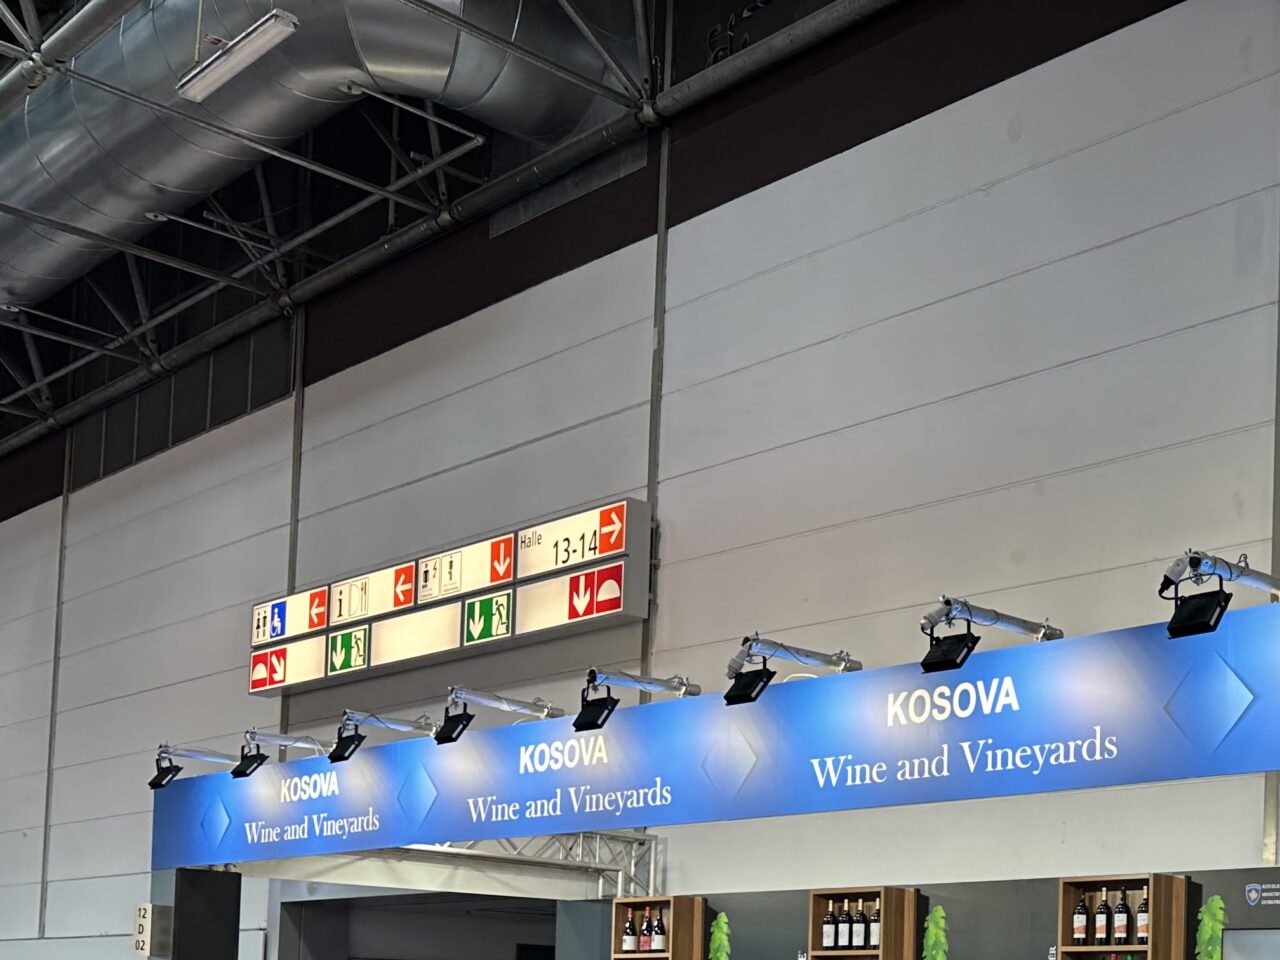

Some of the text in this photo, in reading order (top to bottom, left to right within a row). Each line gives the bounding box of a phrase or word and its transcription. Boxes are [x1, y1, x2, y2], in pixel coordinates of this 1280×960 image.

[520, 529, 598, 565] Halle 13-14
[886, 676, 1020, 727] KOSOVA
[519, 734, 609, 774] KOSOVA
[809, 725, 1118, 788] Wine and Vineyards
[280, 769, 340, 803] KOSOVA
[467, 777, 672, 824] Wine and Vineyards
[244, 805, 380, 844] Wine and Vineyards
[138, 907, 147, 919] 12
[138, 923, 144, 935] D
[135, 939, 146, 951] 02
